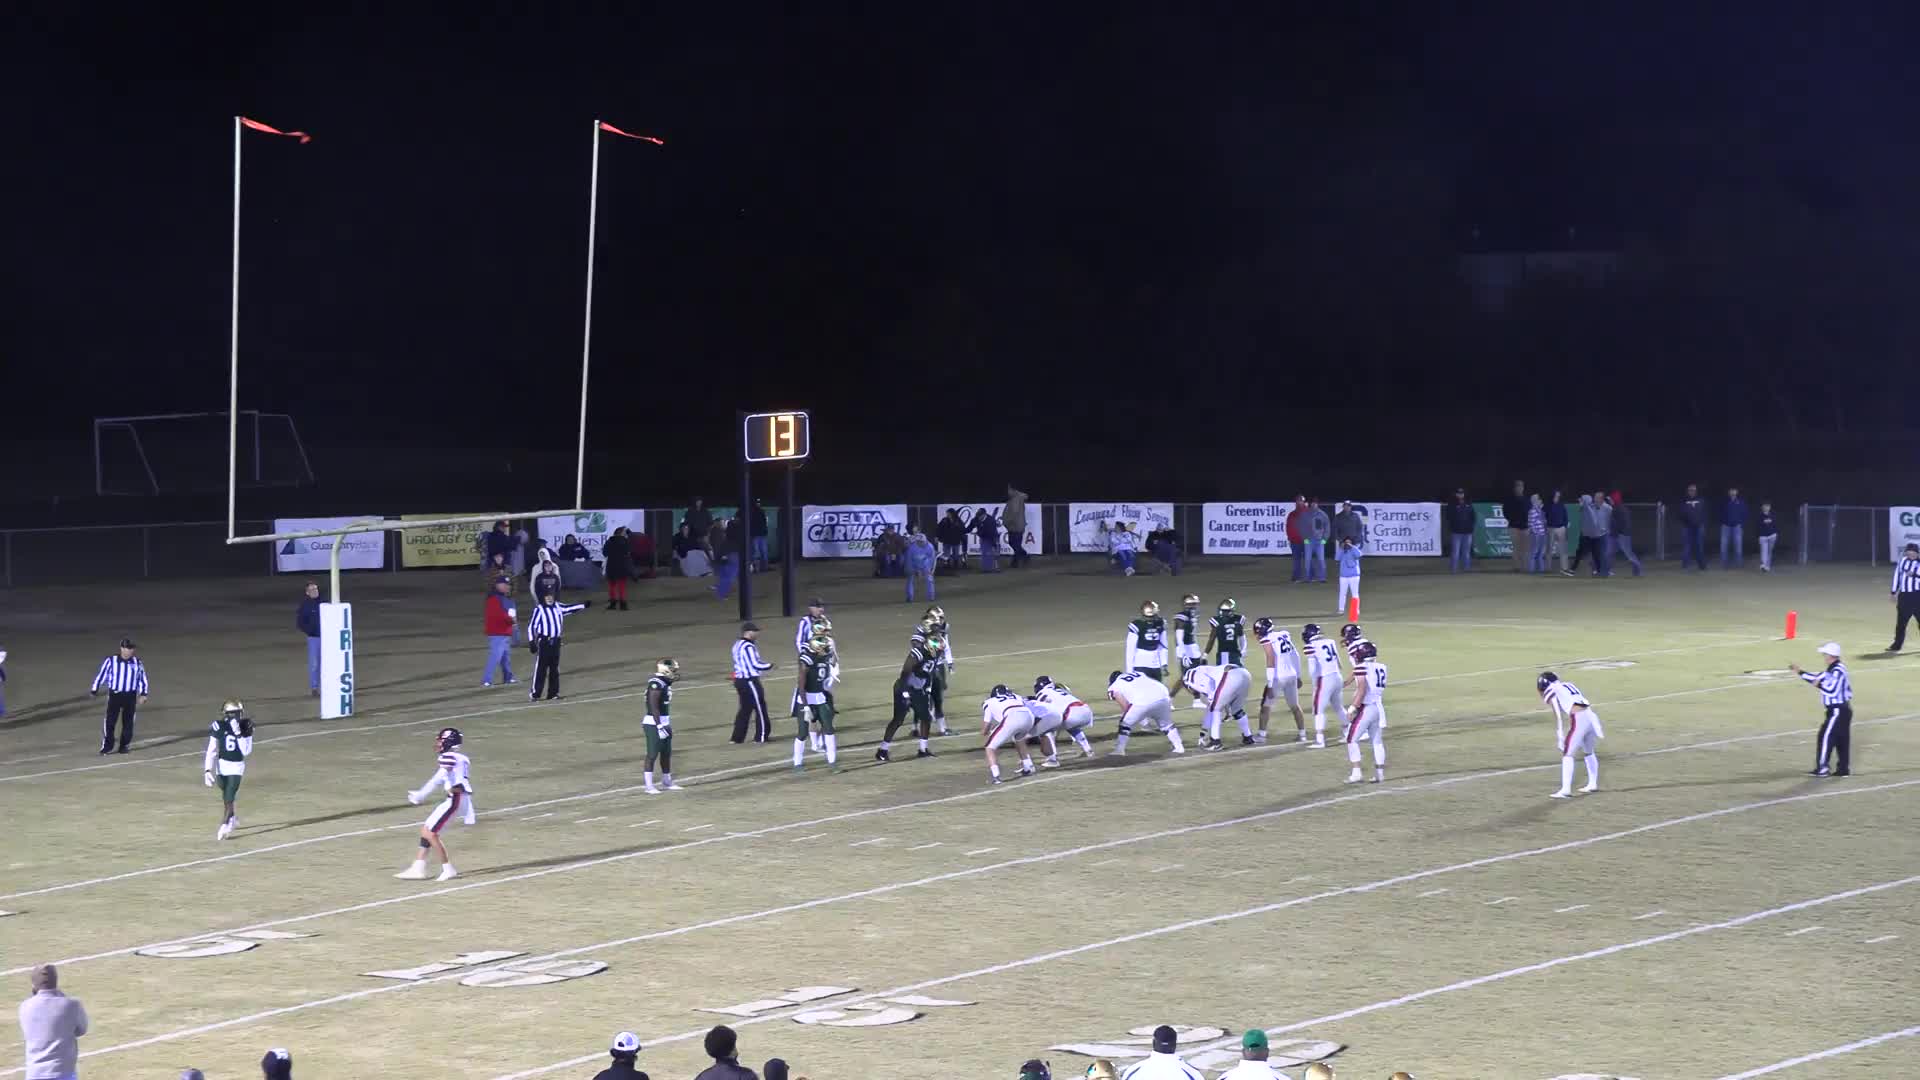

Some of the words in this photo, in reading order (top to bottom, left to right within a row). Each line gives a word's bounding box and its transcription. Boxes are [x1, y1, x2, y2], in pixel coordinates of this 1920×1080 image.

[769, 415, 795, 457] 13
[1226, 505, 1286, 517] Greenville
[1373, 508, 1430, 521] Farmers
[824, 512, 882, 525] DELTA
[1209, 520, 1250, 532] Cancer
[1373, 524, 1412, 537] Grain
[406, 534, 461, 545] UROLOGY
[1373, 538, 1434, 552] Terminal
[1226, 628, 1236, 640] 2
[340, 608, 352, 715] IRISH
[1375, 668, 1386, 689] 12
[225, 734, 236, 752] 6
